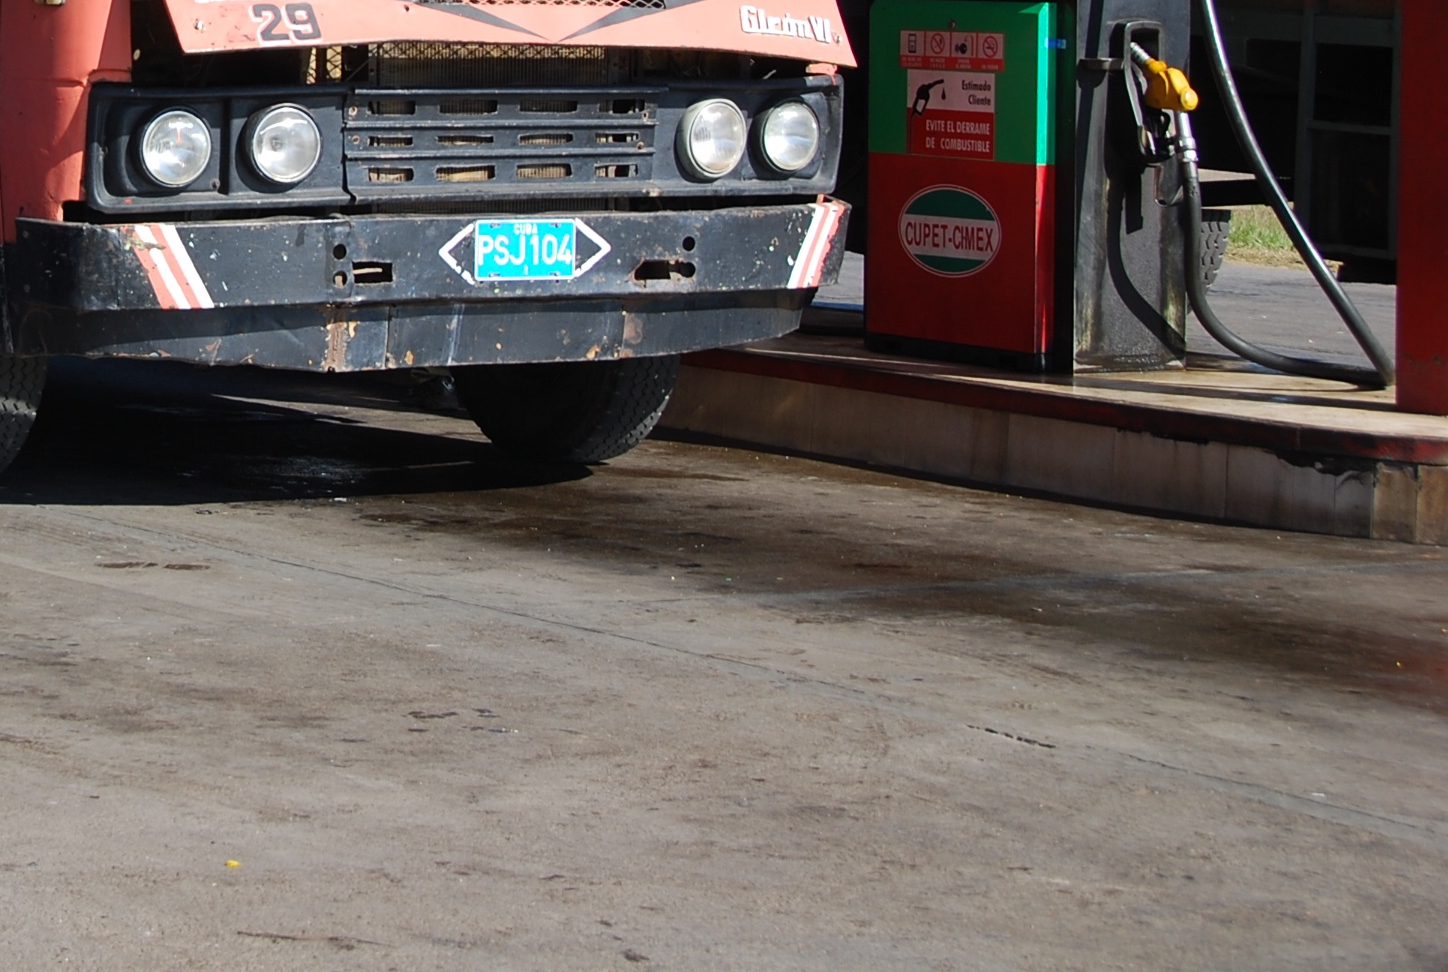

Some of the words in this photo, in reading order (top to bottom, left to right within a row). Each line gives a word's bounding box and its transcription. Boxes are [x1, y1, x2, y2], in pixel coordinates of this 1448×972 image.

[249, 3, 324, 46] 29
[962, 79, 992, 92] Estimado
[968, 95, 992, 106] Cliente
[926, 119, 945, 132] EVITE
[947, 120, 955, 133] EL
[956, 121, 991, 135] DERRAME
[926, 137, 935, 149] DE
[940, 138, 990, 153] COMBUSTIBLE
[514, 223, 538, 235] CUBA
[905, 221, 993, 252] CUPET-CIMEX
[478, 234, 572, 266] PSJ104
